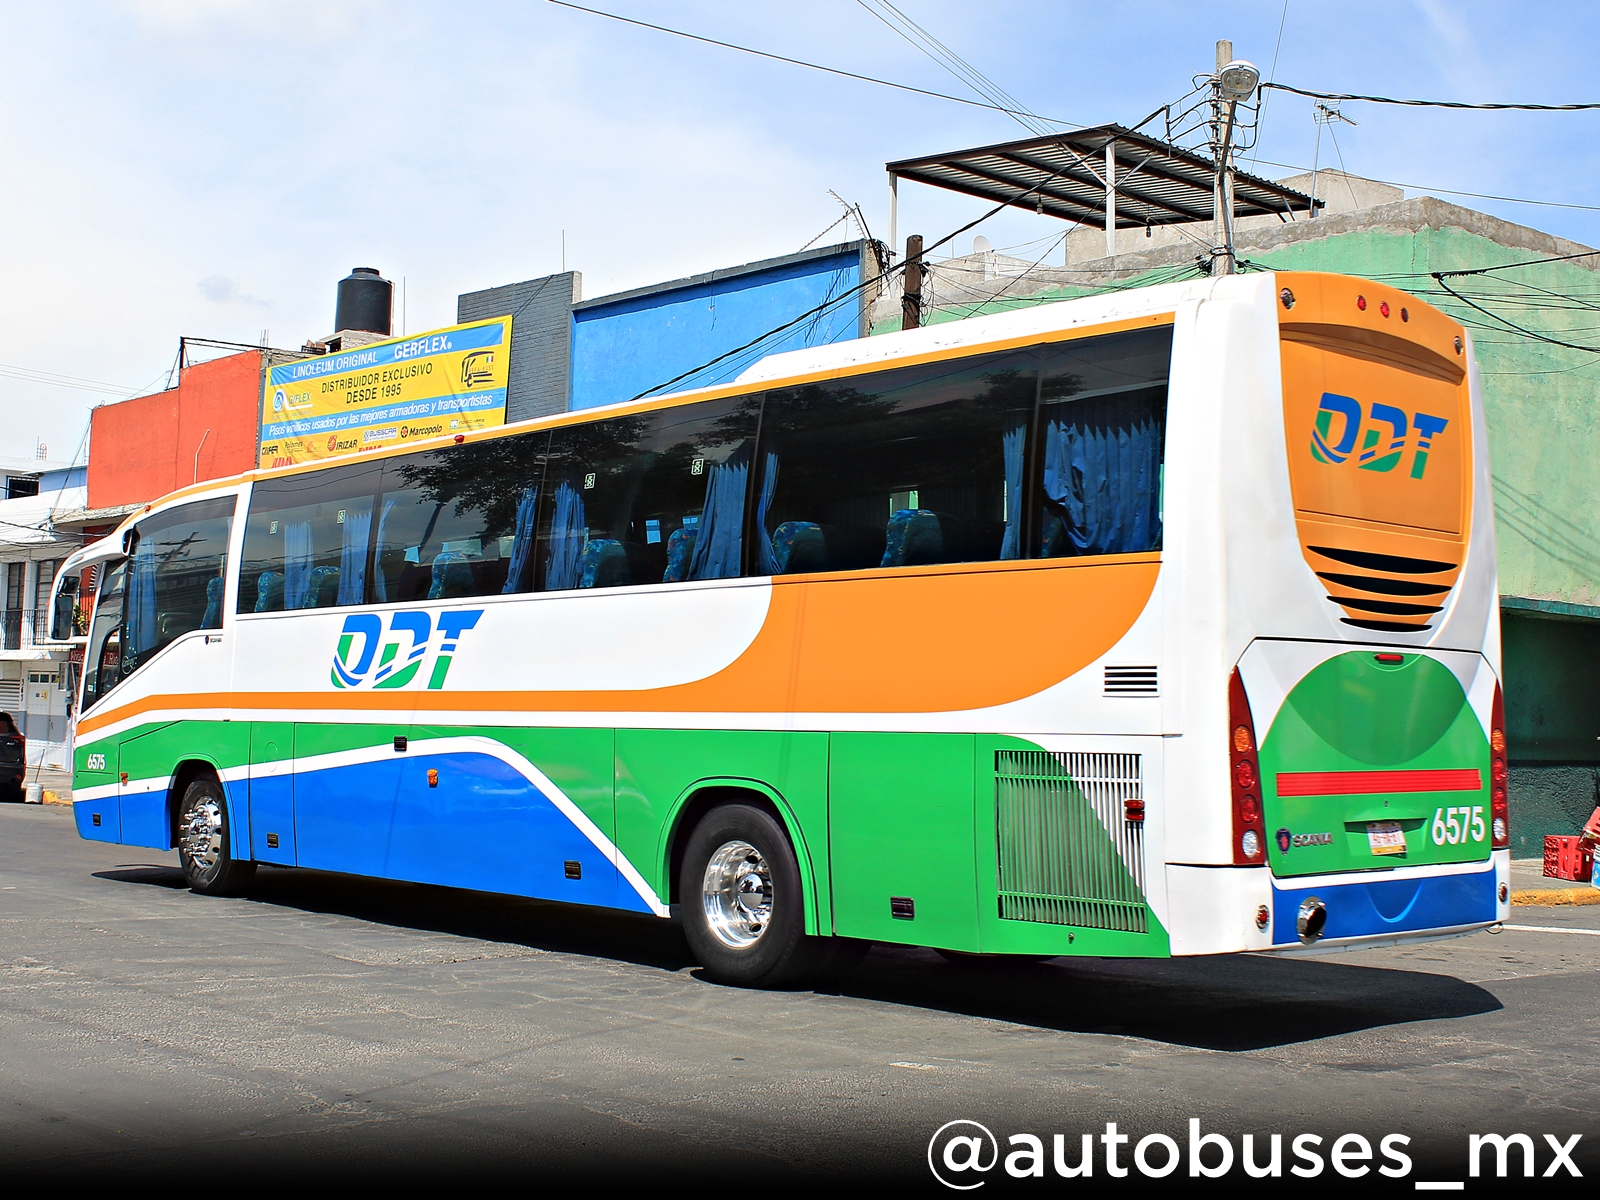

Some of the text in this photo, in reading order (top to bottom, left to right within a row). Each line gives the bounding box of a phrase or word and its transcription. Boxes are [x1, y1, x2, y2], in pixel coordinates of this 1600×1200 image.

[293, 359, 335, 379] LINOLEUM
[336, 351, 378, 370] ORIGINAL
[321, 362, 433, 393] DISTRIBUIDOR EXCLUSIVO
[346, 383, 402, 404] DESDE 1995
[269, 424, 286, 437] Pisos
[311, 416, 336, 430] usados
[335, 416, 349, 429] por
[349, 413, 360, 425] las
[360, 410, 389, 424] mejores
[388, 401, 430, 418] armadoras
[430, 403, 438, 415] y
[438, 394, 493, 412] transportistas
[408, 424, 443, 437] Marcopolo
[336, 439, 358, 450] IRIZAR
[87, 753, 106, 770] 6575
[1431, 806, 1486, 846] 6575
[1291, 832, 1334, 847] SCANIA
